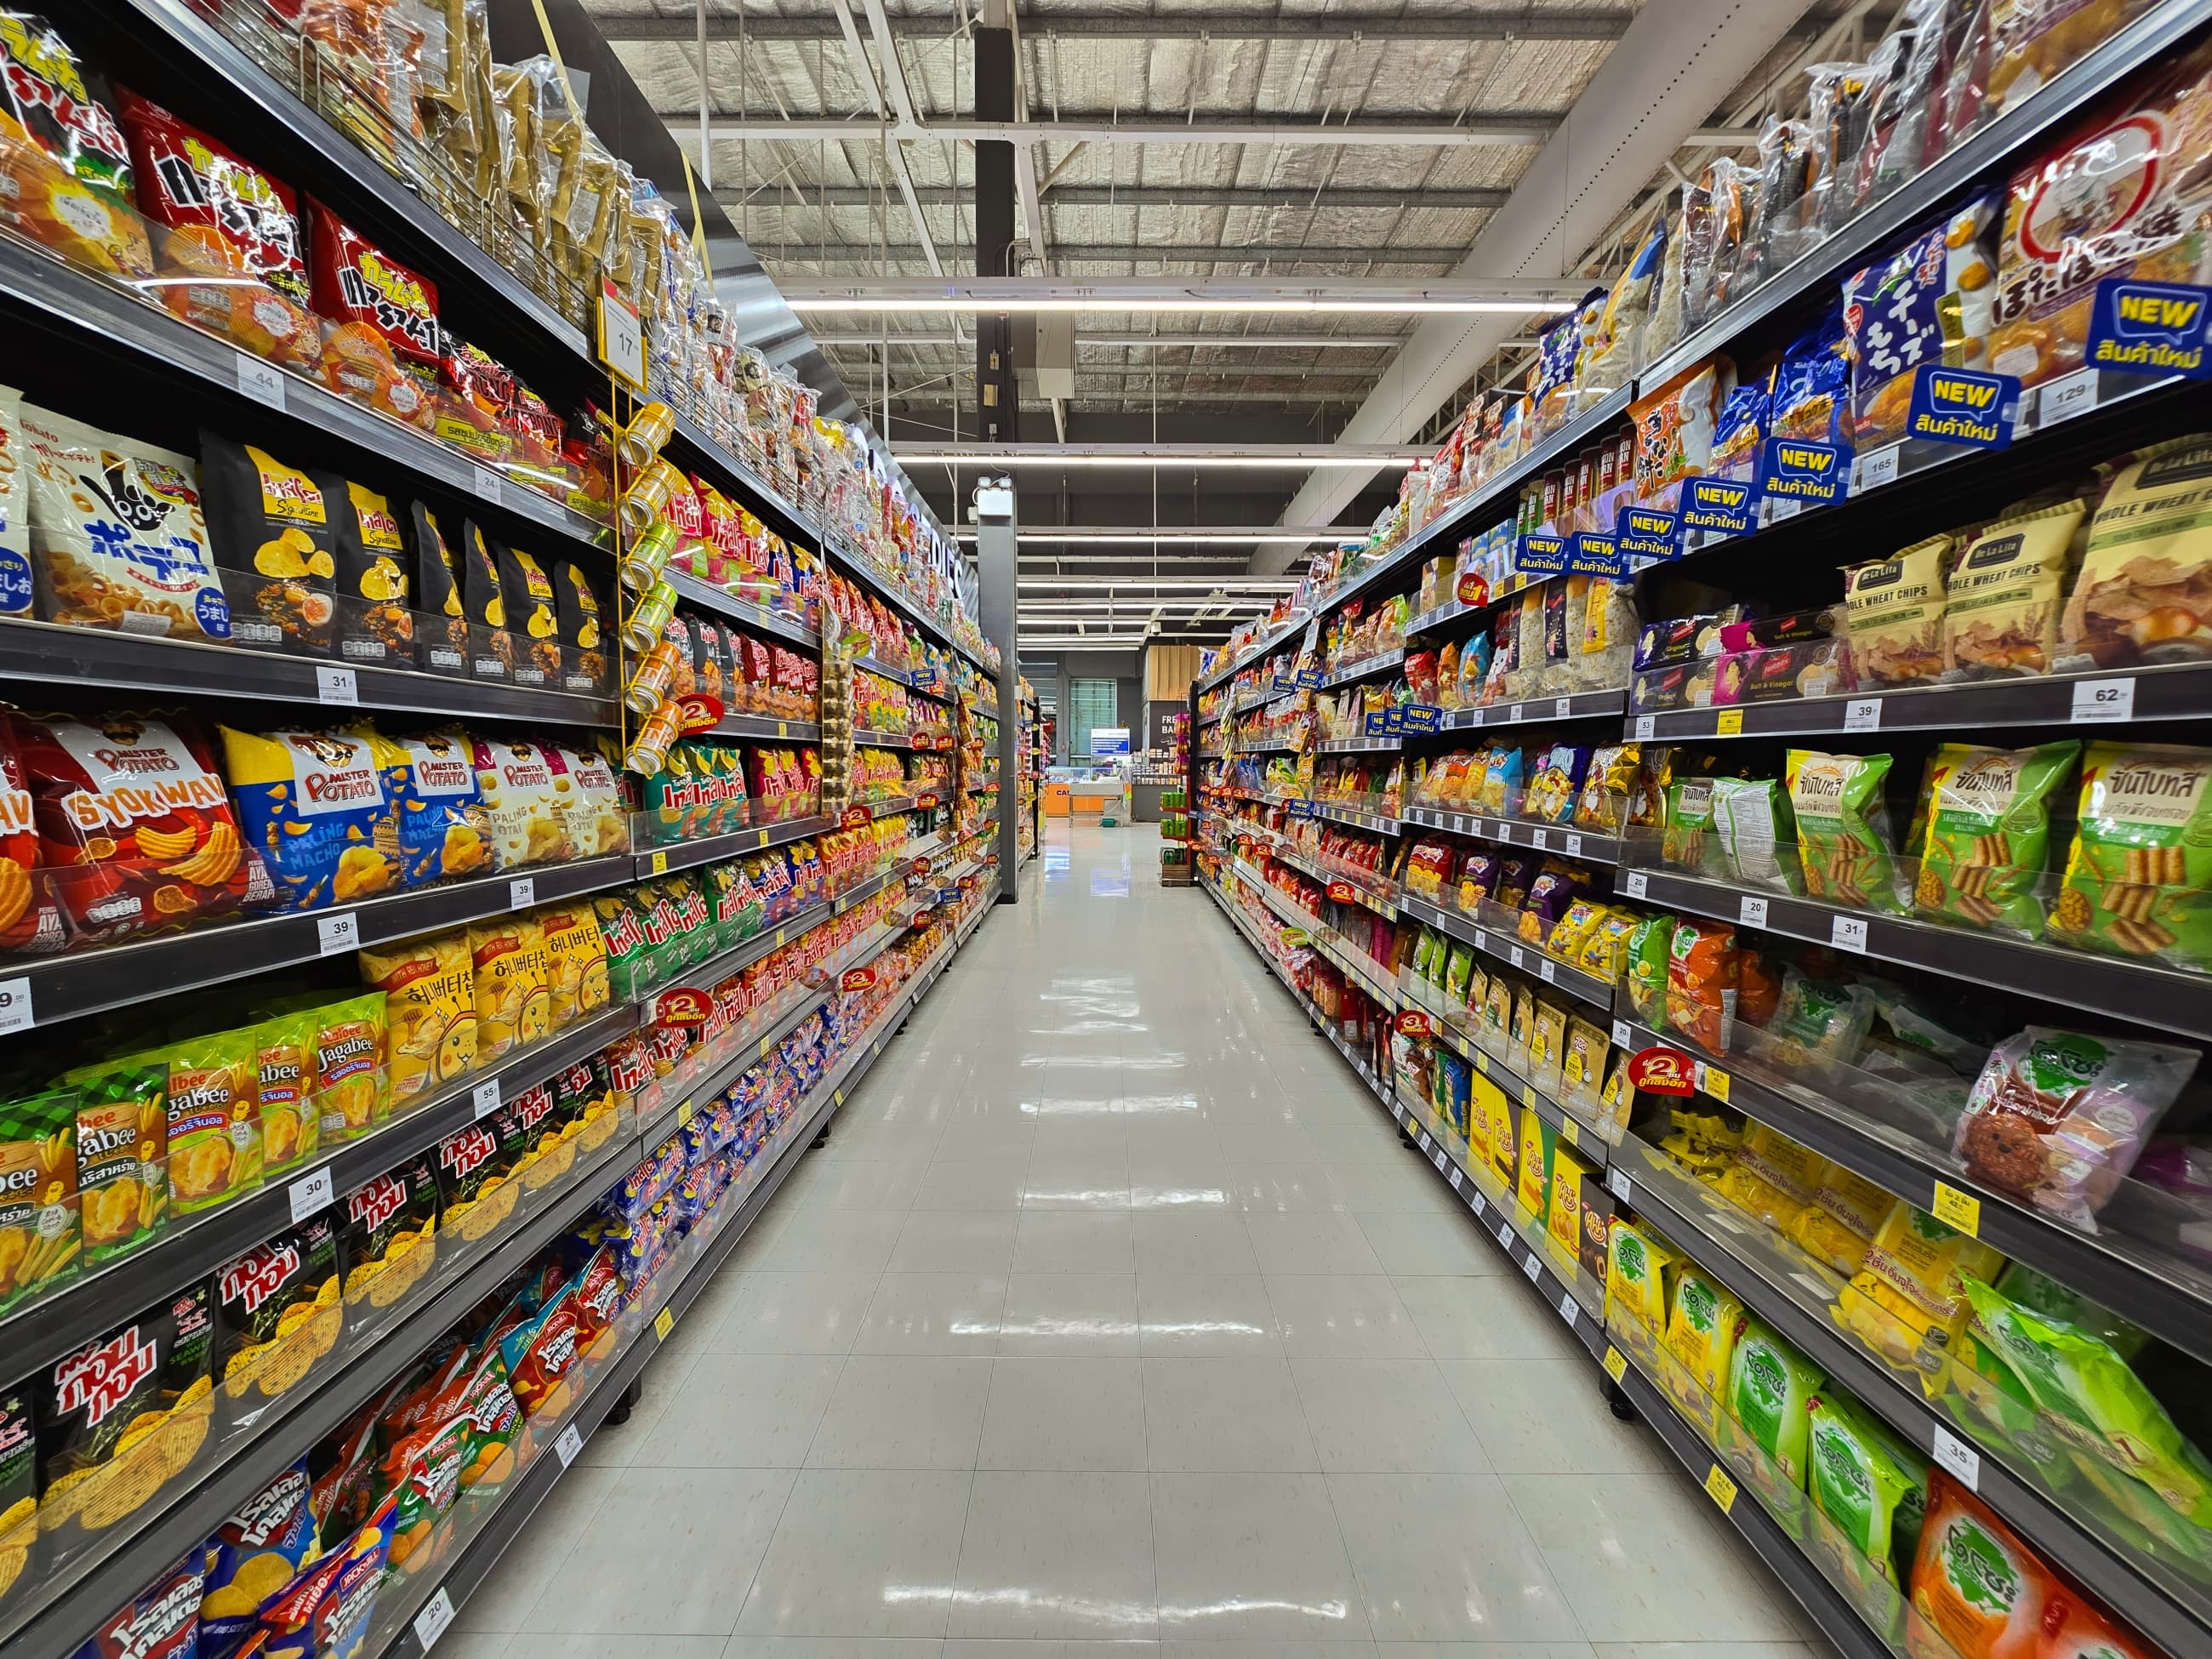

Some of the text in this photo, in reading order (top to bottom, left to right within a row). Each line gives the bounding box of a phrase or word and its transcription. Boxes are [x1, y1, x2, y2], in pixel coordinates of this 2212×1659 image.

[2120, 295, 2199, 328] NEW
[619, 333, 633, 356] 17
[2095, 339, 2203, 369] สินค้าใหม่
[1935, 379, 1996, 408] NEW
[2056, 384, 2086, 405] 129
[1916, 413, 1998, 442] สินค้าใหม่
[1782, 449, 1832, 471] NEW
[1872, 459, 1891, 473] 165
[1766, 476, 1835, 499] สินค้าใหม่
[1697, 487, 1744, 506] NEW
[2143, 493, 2197, 513] WHEAT
[1632, 516, 1672, 533] NEW
[1684, 510, 1747, 530] สินค้าใหม่
[1528, 538, 1561, 553] NEW
[1582, 540, 1615, 556] NEW
[1620, 537, 1674, 556] สินค้าใหม่
[1987, 545, 1997, 556] La
[1998, 541, 2017, 554] Lita
[1519, 556, 1565, 571] สินค้าใหม่
[1571, 560, 1621, 575] สินค้าใหม่
[1973, 570, 2006, 587] WHEAT
[2010, 562, 2042, 579] CHIPS
[1870, 592, 1894, 607] WHEAT
[1897, 585, 1928, 600] CHIPS
[333, 676, 347, 687] 31
[1302, 672, 1318, 681] NEW
[1750, 681, 1762, 691] Salt
[1769, 680, 1794, 691] Vinegar
[2095, 688, 2118, 702] 62
[1410, 708, 1434, 721] NEW
[1858, 706, 1872, 716] 39
[117, 749, 167, 759] MISTER
[419, 761, 467, 787] POTATO
[430, 761, 464, 772] MISTER
[516, 765, 544, 774] MISTER
[329, 769, 370, 783] MISTER
[305, 770, 375, 802] POTATO
[493, 807, 527, 823] PALING
[249, 866, 270, 881] AYA
[519, 886, 528, 894] 39
[1751, 903, 1761, 912] 20
[334, 922, 349, 934] 39
[1845, 924, 1858, 935] 31
[1620, 1027, 1627, 1036] 20
[318, 1037, 374, 1072] Jagabee
[169, 1074, 207, 1092] lbee
[1639, 1075, 1687, 1089] ถูกลงอีก
[483, 1088, 493, 1100] 55
[306, 1179, 323, 1195] 30
[565, 1433, 574, 1446] 20
[1949, 1444, 1968, 1464] 35
[429, 1601, 442, 1620] 20
